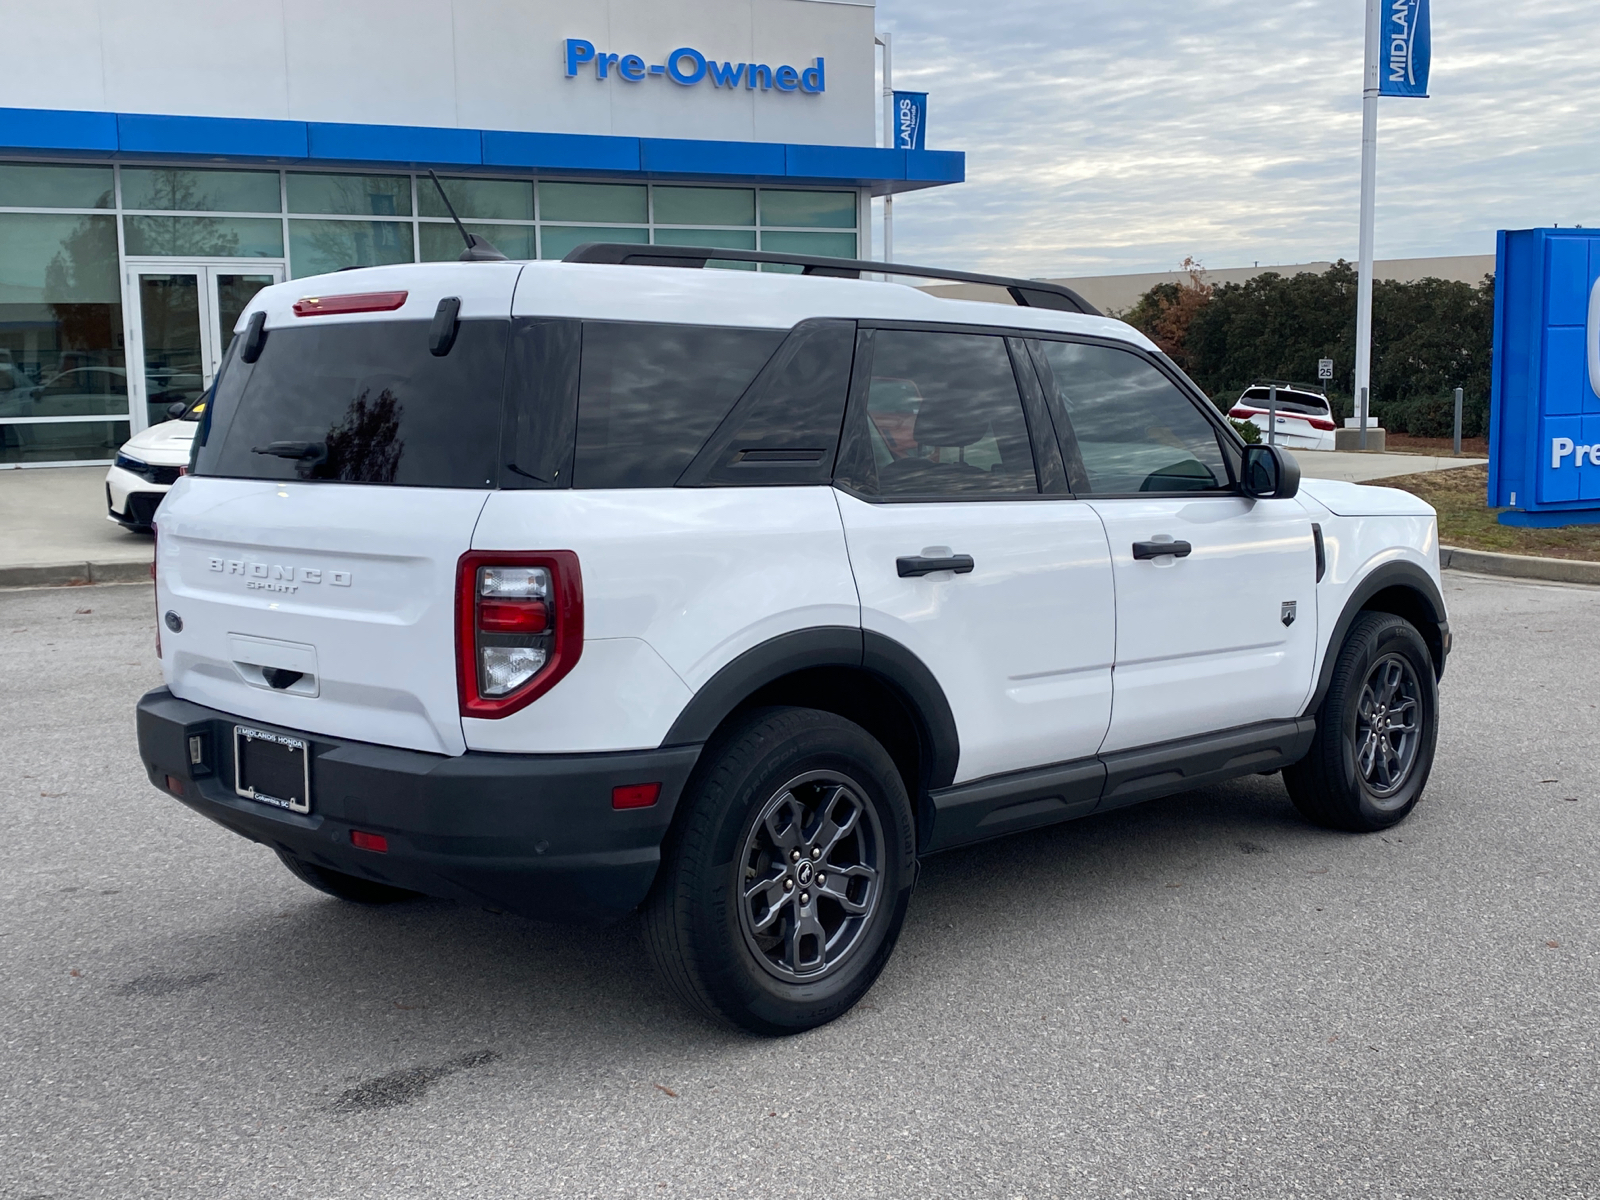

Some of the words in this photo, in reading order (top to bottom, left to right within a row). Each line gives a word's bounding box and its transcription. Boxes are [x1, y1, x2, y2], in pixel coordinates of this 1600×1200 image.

[564, 38, 825, 93] Pre-Owned
[1320, 368, 1331, 376] 25
[1551, 437, 1600, 468] Pre
[208, 557, 352, 587] BRONCO
[246, 580, 298, 594] SPORT
[242, 727, 276, 741] MIDLANDS
[278, 737, 303, 748] HONDA
